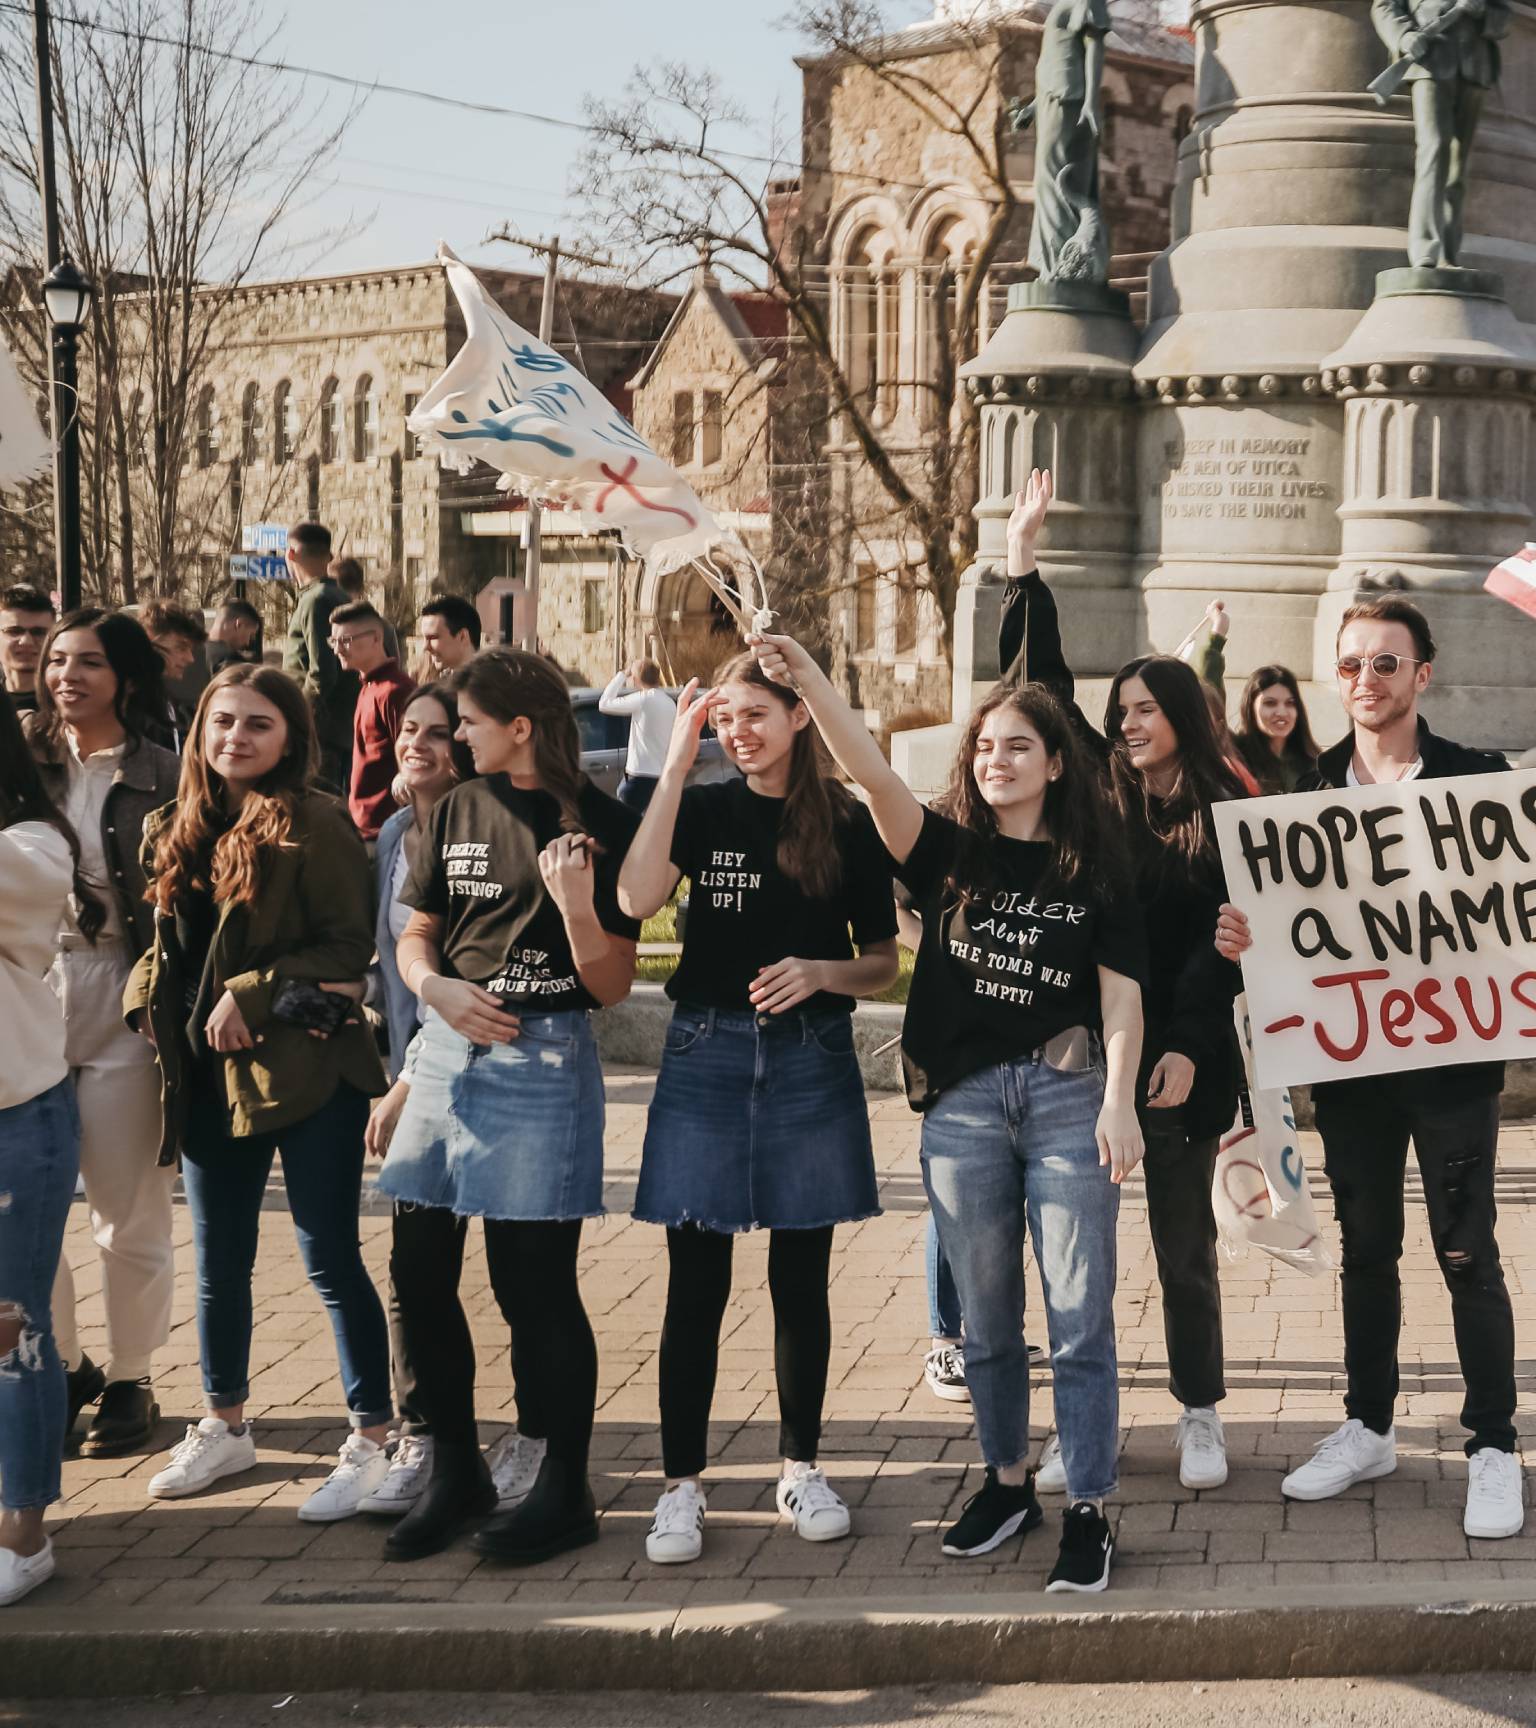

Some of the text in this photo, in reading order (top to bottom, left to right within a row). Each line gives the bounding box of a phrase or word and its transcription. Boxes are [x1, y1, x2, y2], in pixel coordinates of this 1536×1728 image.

[1221, 439, 1235, 455] IN
[1240, 438, 1311, 456] MEMORY
[1194, 461, 1221, 475] MEN
[1226, 461, 1245, 475] OF
[1252, 461, 1301, 476] UTICA
[1177, 482, 1222, 497] RISKED
[1229, 481, 1274, 497] THEIR
[1280, 481, 1328, 497] LIVES
[1181, 503, 1214, 518] SAVE
[1219, 503, 1249, 518] THE
[1253, 503, 1306, 519] UNION
[248, 557, 288, 577] Sta
[1238, 805, 1411, 893] HOPE
[447, 860, 489, 876] ERE IS
[711, 851, 746, 867] HEY
[455, 880, 503, 899] STING?
[699, 871, 762, 889] LISTEN
[711, 891, 742, 912] UP!
[973, 887, 1087, 924] OILER
[971, 917, 1044, 945] Alert
[1290, 907, 1352, 961] a
[949, 939, 1072, 988] THE TOMB WAS
[487, 978, 528, 993] YOUR
[974, 978, 1034, 1005] EMPTY!
